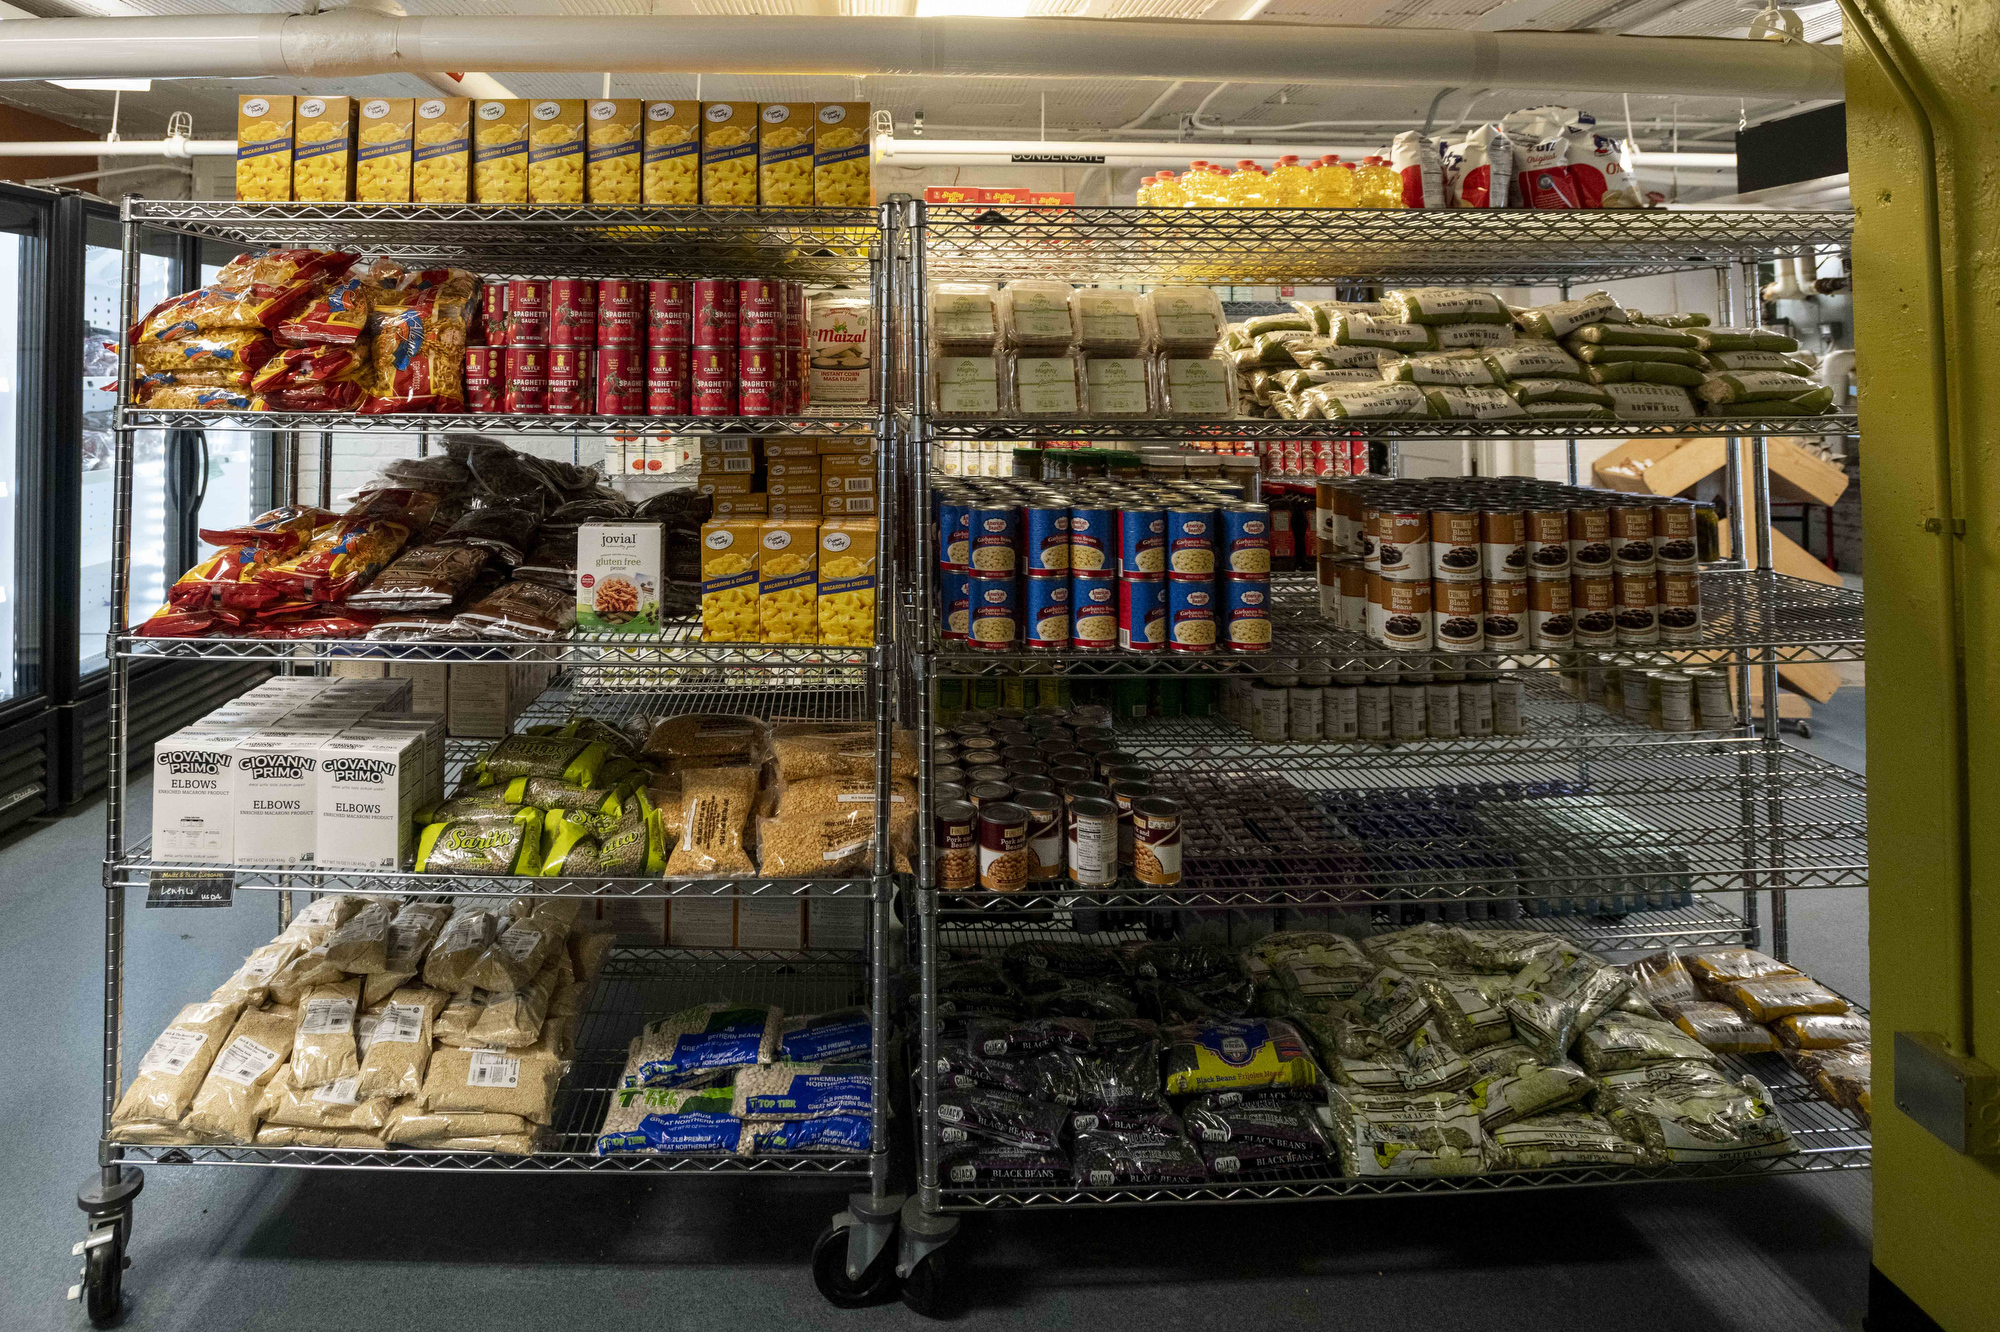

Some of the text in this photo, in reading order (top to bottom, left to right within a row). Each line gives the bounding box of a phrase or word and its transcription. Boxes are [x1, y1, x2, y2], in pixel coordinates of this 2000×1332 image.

[1013, 154, 1104, 162] CONDENSATE
[942, 191, 964, 201] Stuffing
[993, 192, 1016, 202] Stuffing
[818, 328, 867, 342] Maizal
[956, 366, 979, 374] Mighty
[1105, 368, 1127, 376] Mighty
[1185, 368, 1208, 376] Mighty
[1614, 387, 1682, 396] FLICKERTAIL
[1632, 404, 1658, 412] BROWN
[600, 532, 636, 548] jovial
[596, 558, 642, 567] gluten free
[706, 580, 731, 590] MACARONI
[736, 575, 752, 584] CHEESE
[764, 581, 788, 590] MACARONI
[794, 576, 811, 584] CHEESE
[822, 582, 846, 592] MACARONI
[157, 751, 232, 767] GIOVANNI
[239, 755, 316, 772] GIOVANNI
[170, 762, 219, 775] PRIMO
[322, 758, 396, 776] GIOVANNI
[253, 768, 302, 780] PRIMO
[335, 770, 382, 784] PRIMO
[171, 779, 217, 790] ELBOWS
[253, 800, 300, 810] ELBOWS
[336, 802, 381, 814] ELBOWS
[446, 828, 514, 851] Sarita
[946, 836, 962, 844] Pork
[950, 841, 970, 849] Beans
[1196, 1072, 1264, 1084] Black Beans Frijoles
[758, 1099, 796, 1108] TOP TIER
[650, 1117, 674, 1126] GREAT
[674, 1117, 715, 1125] NORTHERN
[610, 1136, 646, 1146] TOP TIER
[1276, 1139, 1306, 1150] BEANS
[1718, 1150, 1762, 1160] SPLIT PEAS
[1256, 1156, 1286, 1166] BLACK
[992, 1169, 1054, 1178] BLACK BEANS
